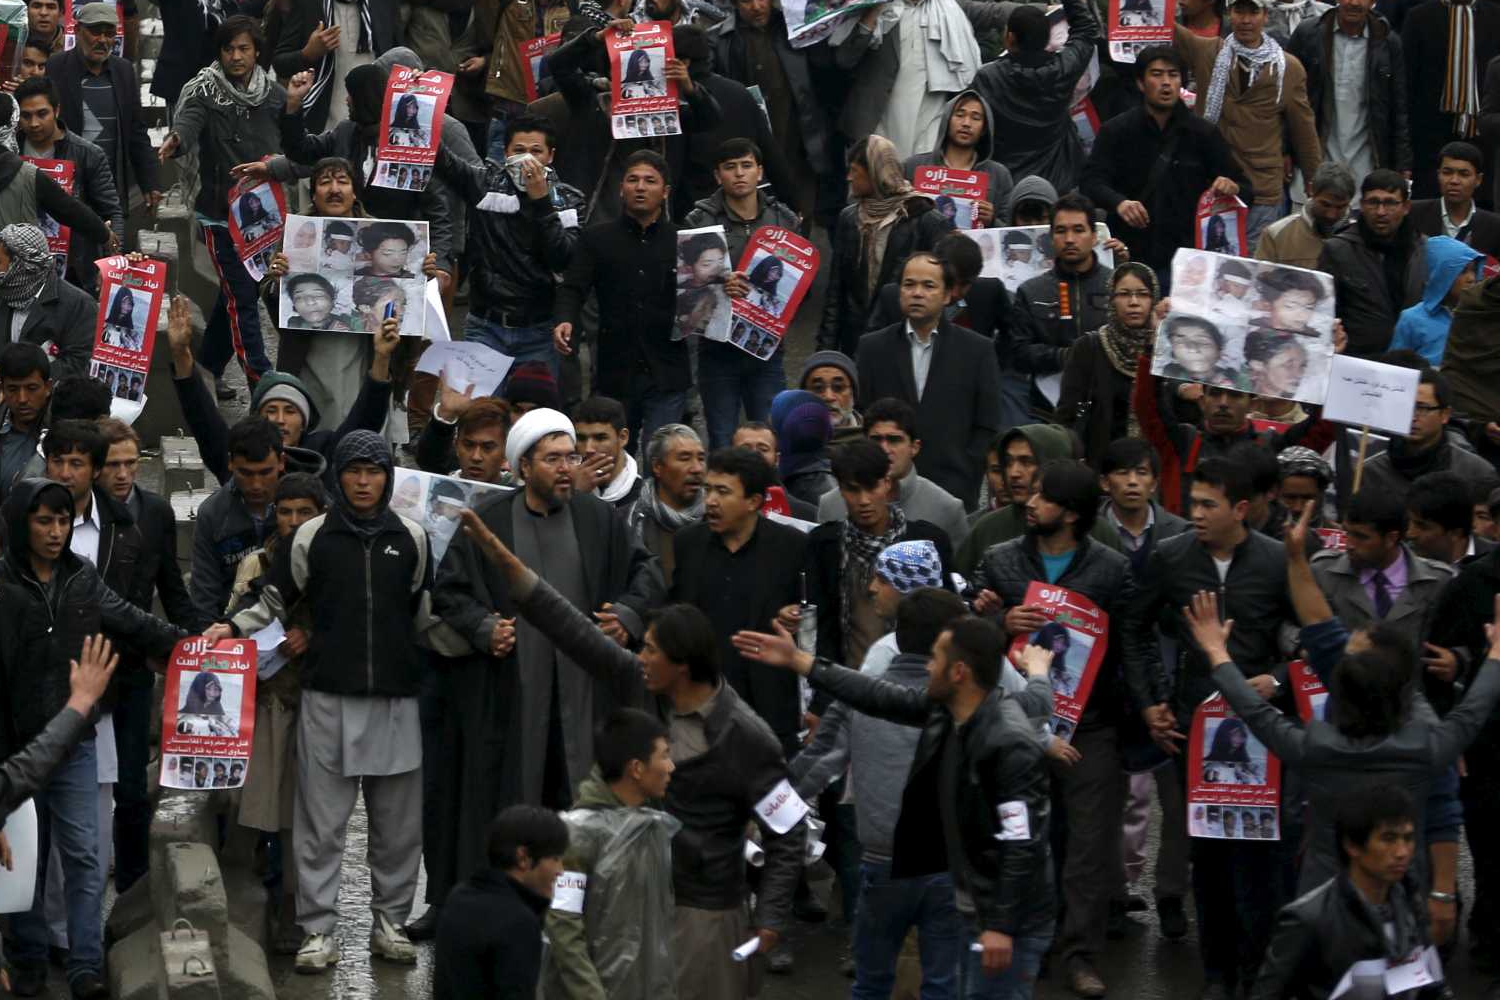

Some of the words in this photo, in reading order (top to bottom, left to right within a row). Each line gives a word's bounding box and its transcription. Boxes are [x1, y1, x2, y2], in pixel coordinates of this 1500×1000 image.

[926, 169, 977, 183] هزاره
[766, 228, 813, 257] هزاره
[108, 256, 155, 274] هزاره
[1039, 588, 1099, 618] هزاره
[183, 639, 244, 655] هزاره
[176, 657, 199, 667] است
[230, 658, 250, 670] نماد
